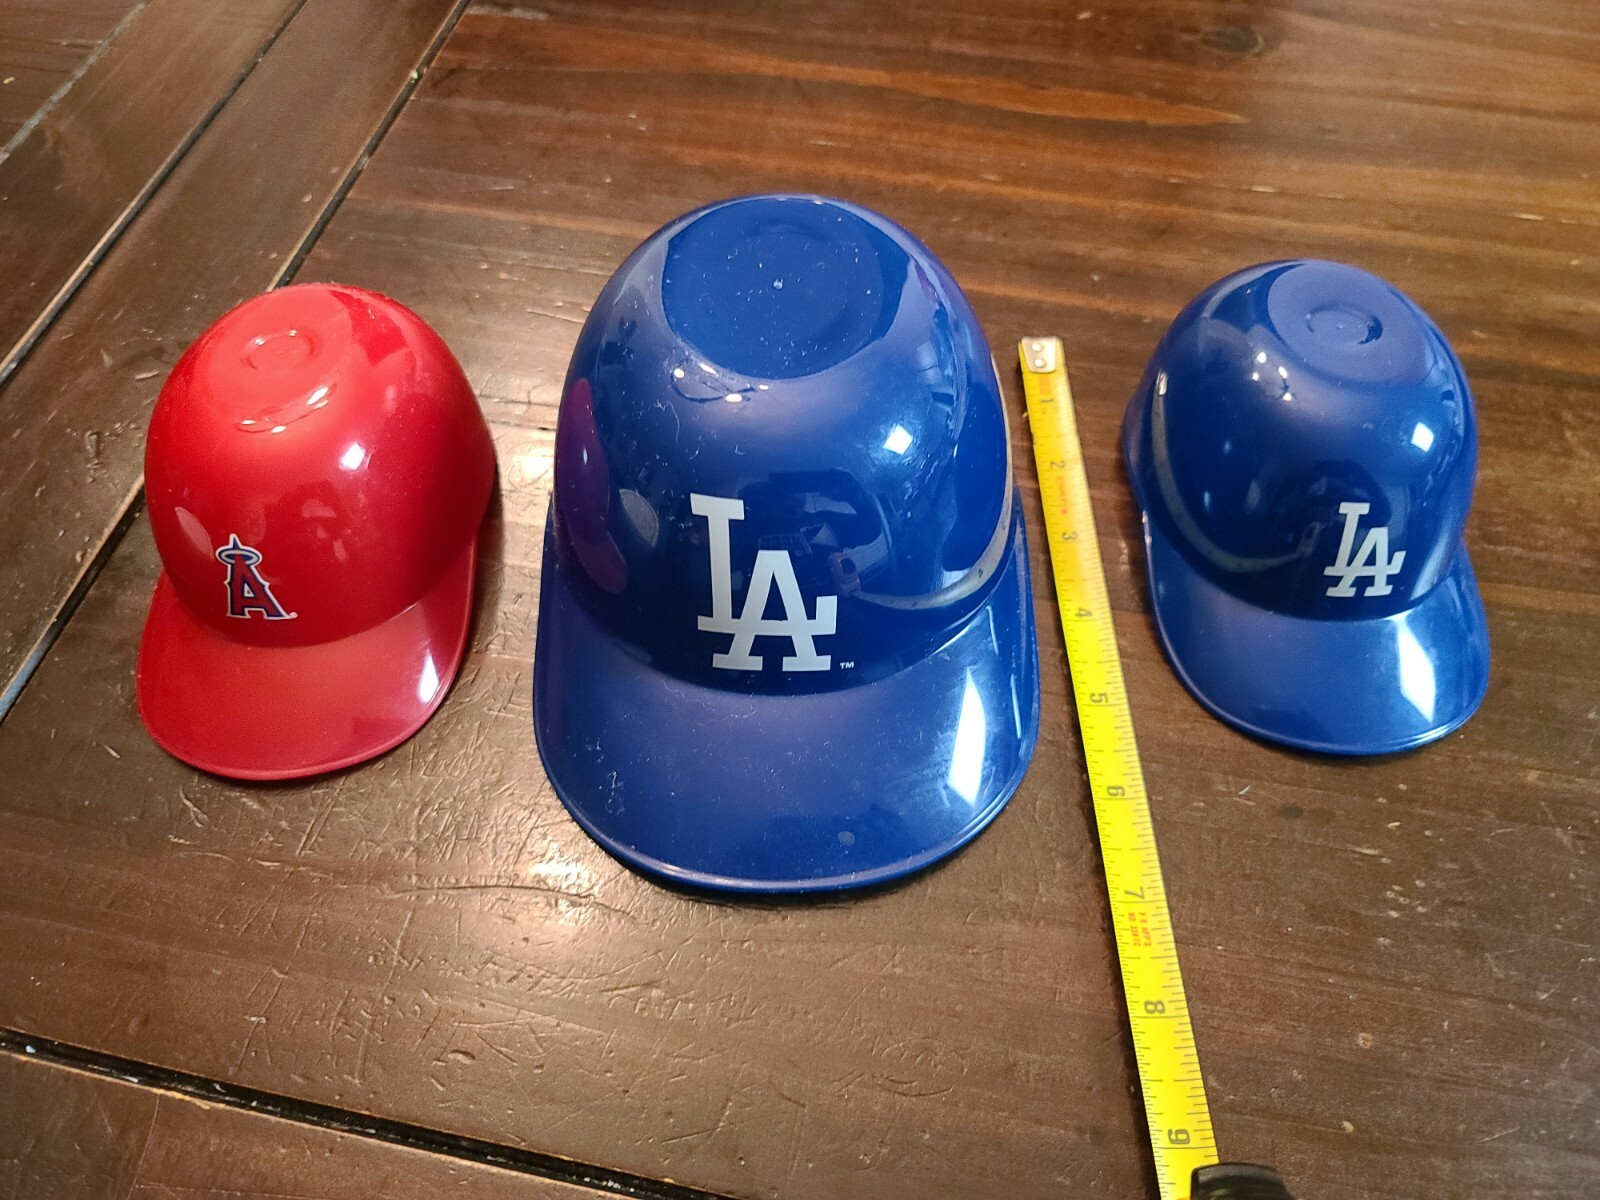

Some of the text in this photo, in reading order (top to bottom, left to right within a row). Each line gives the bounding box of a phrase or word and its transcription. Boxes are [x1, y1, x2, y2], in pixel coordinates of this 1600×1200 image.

[1049, 460, 1066, 470] 2
[1061, 531, 1078, 541] 3
[1323, 501, 1407, 598] LA
[690, 492, 838, 672] LA
[1074, 607, 1093, 618] 4
[1089, 692, 1109, 704] 5
[1106, 785, 1125, 797] 6
[1123, 886, 1145, 900] 7
[1143, 999, 1166, 1015] 8
[1167, 1128, 1191, 1145] 9
